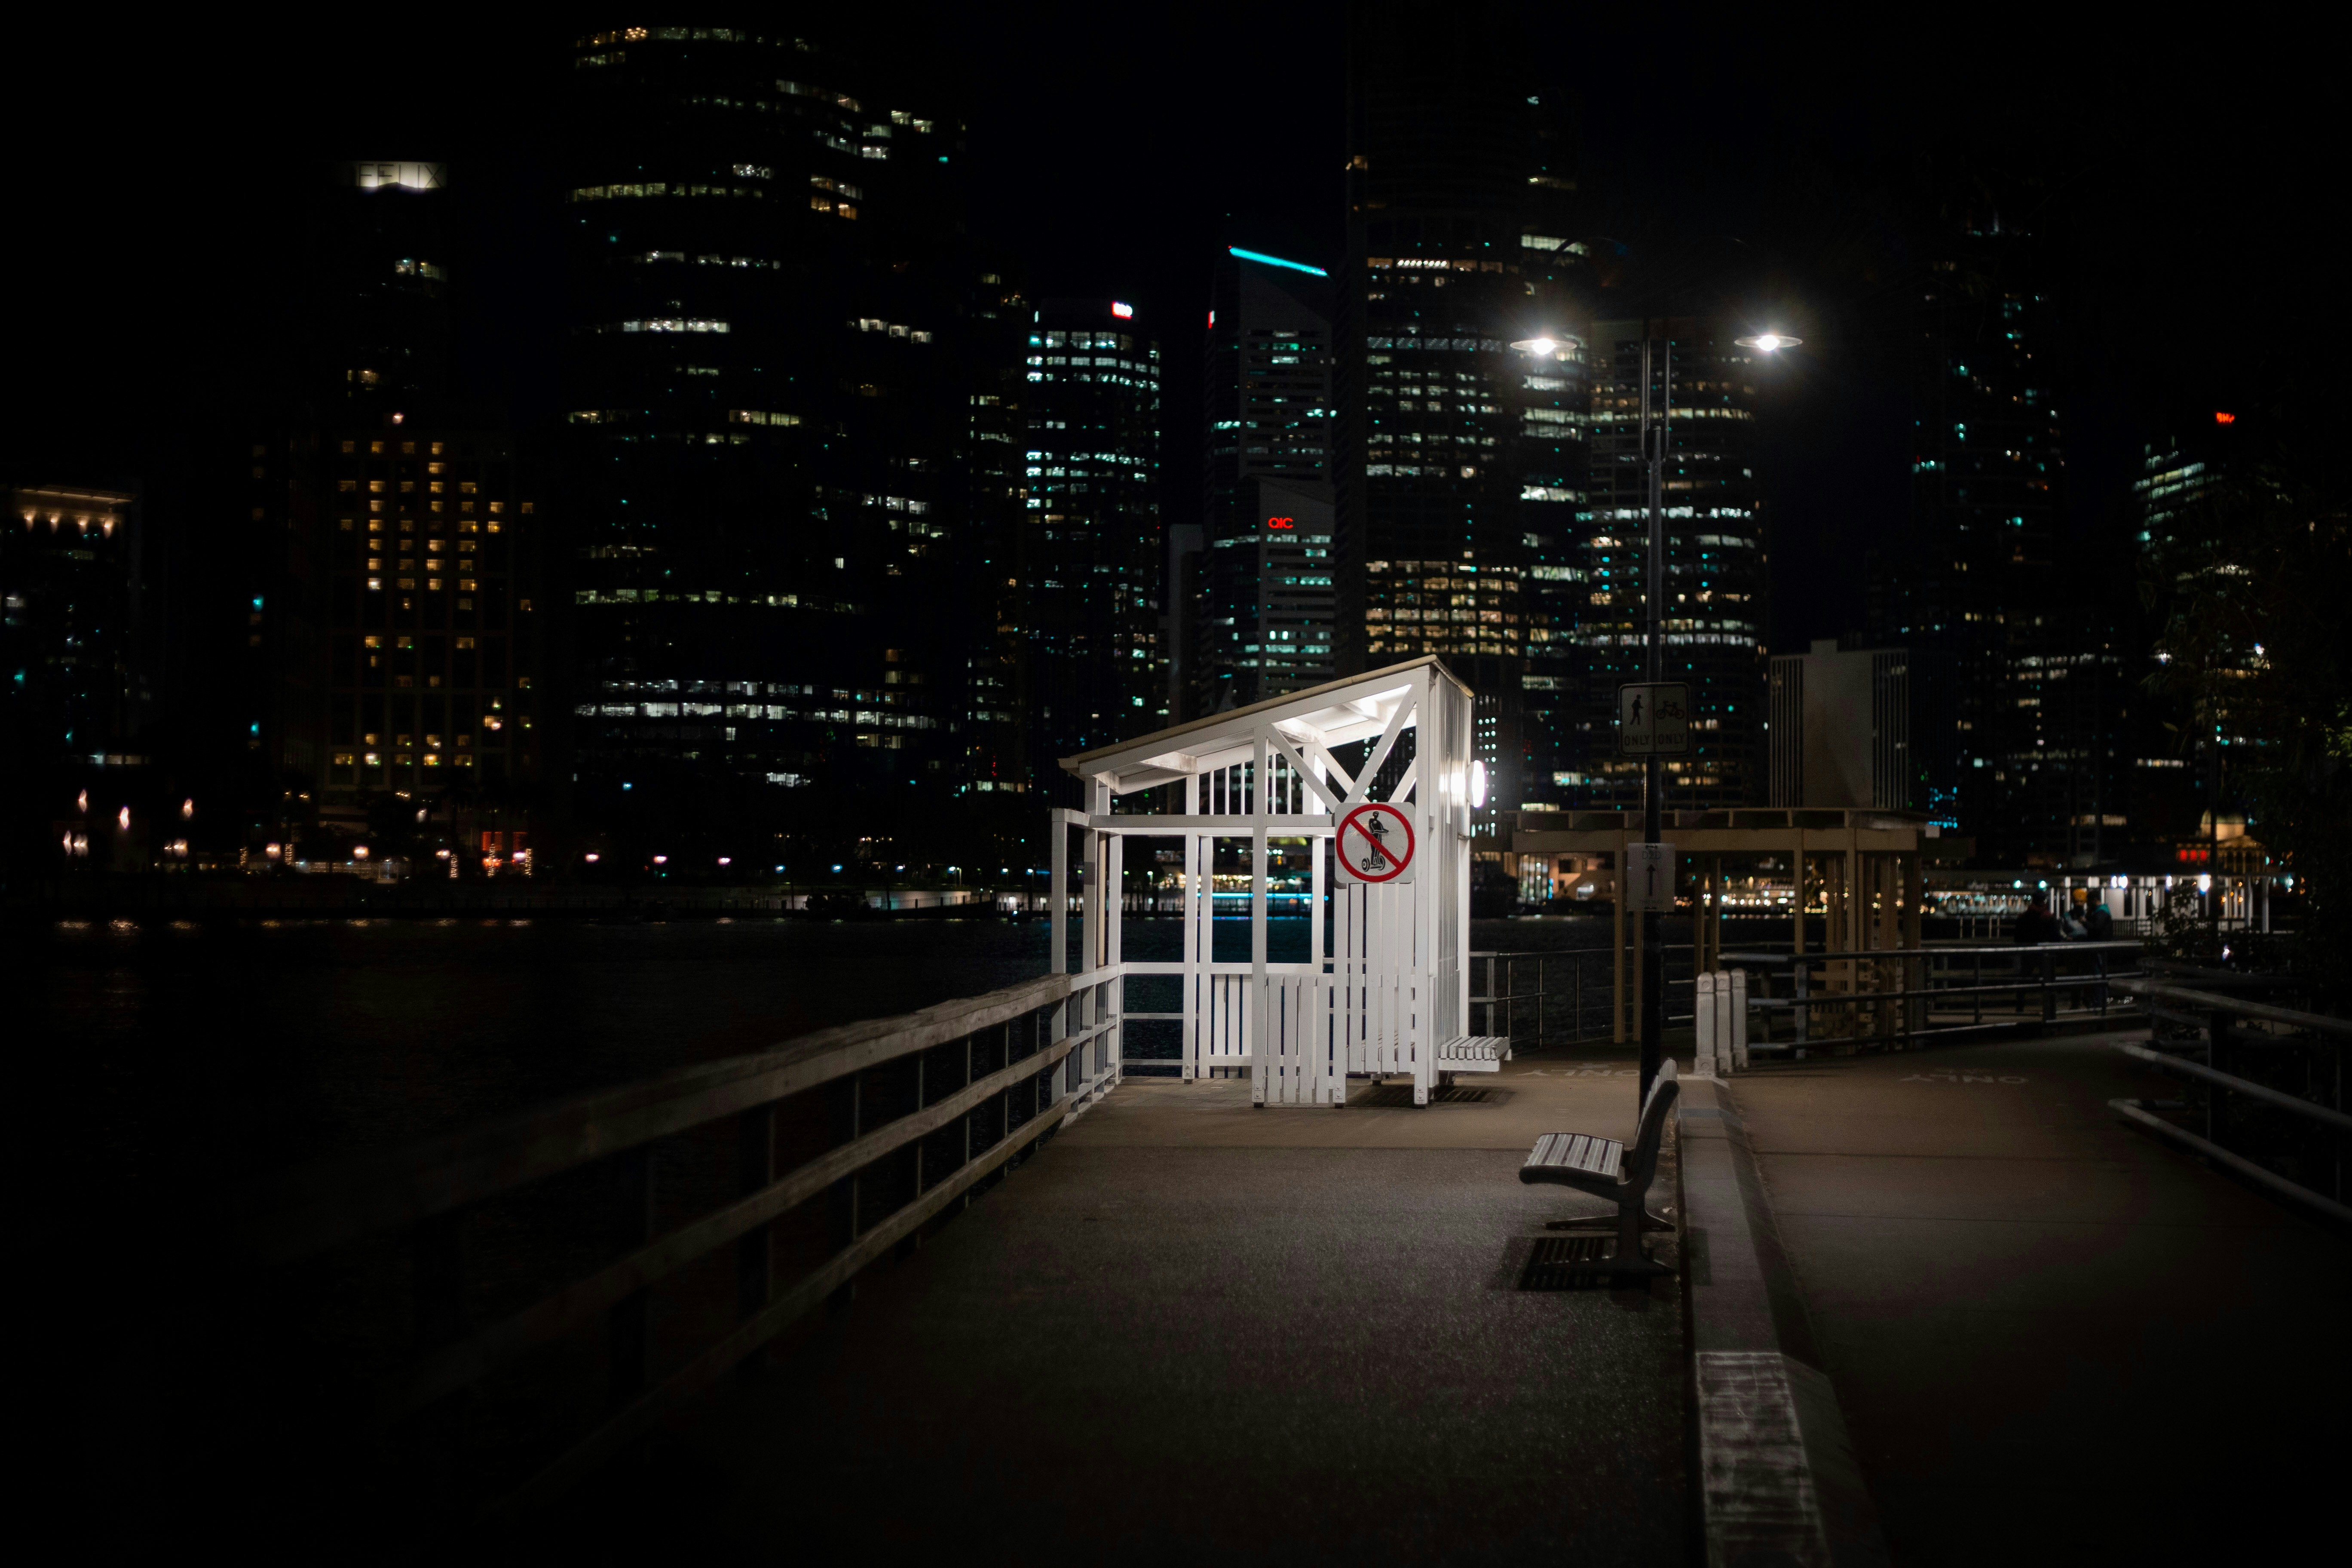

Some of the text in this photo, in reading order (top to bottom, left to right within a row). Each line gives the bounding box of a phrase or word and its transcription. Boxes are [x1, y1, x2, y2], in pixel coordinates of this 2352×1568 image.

[1624, 733, 1685, 746] ONLY ONLY
[1899, 1075, 2028, 1084] ONLY
